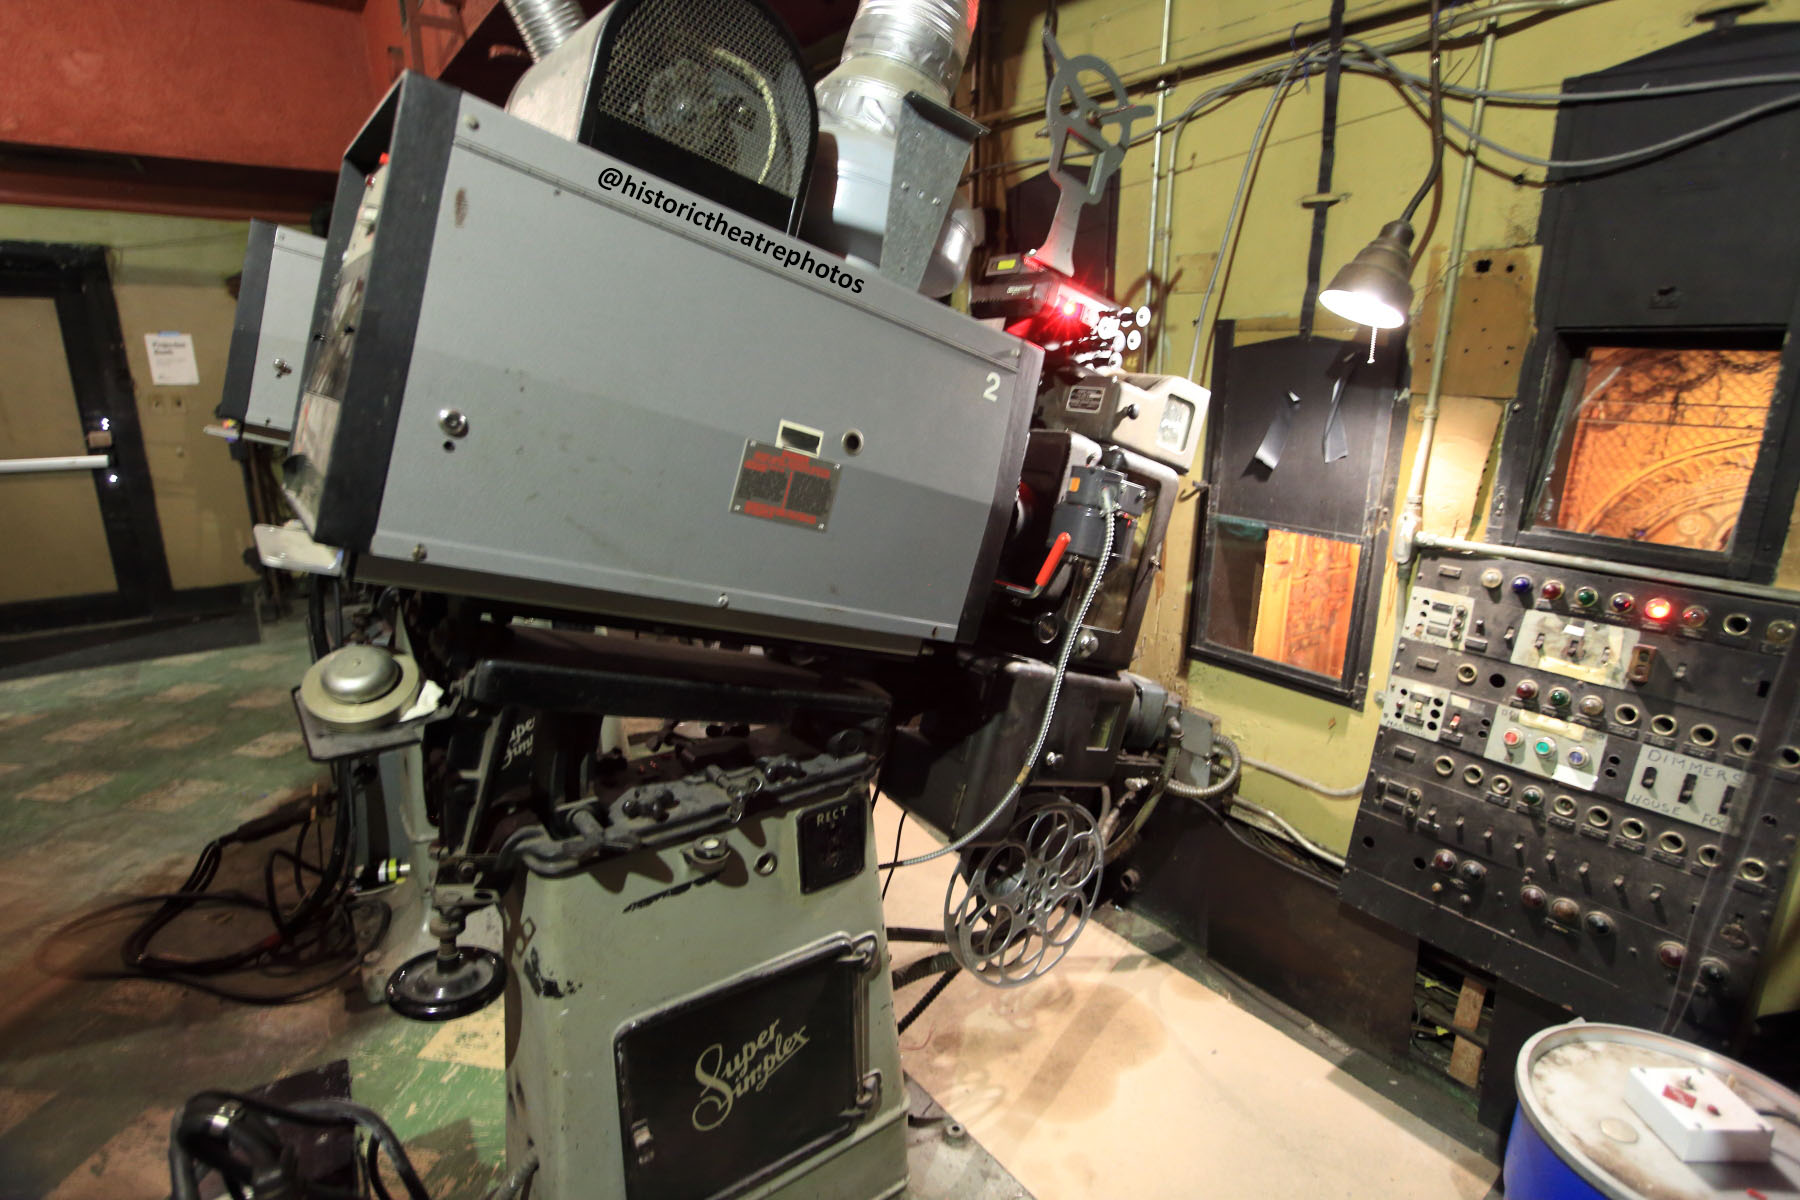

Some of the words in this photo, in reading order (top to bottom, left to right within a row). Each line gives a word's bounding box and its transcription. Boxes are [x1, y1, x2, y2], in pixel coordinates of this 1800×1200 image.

[983, 371, 1001, 402] 2
[1631, 794, 1681, 816] HOUSE
[692, 1018, 780, 1131] Super
